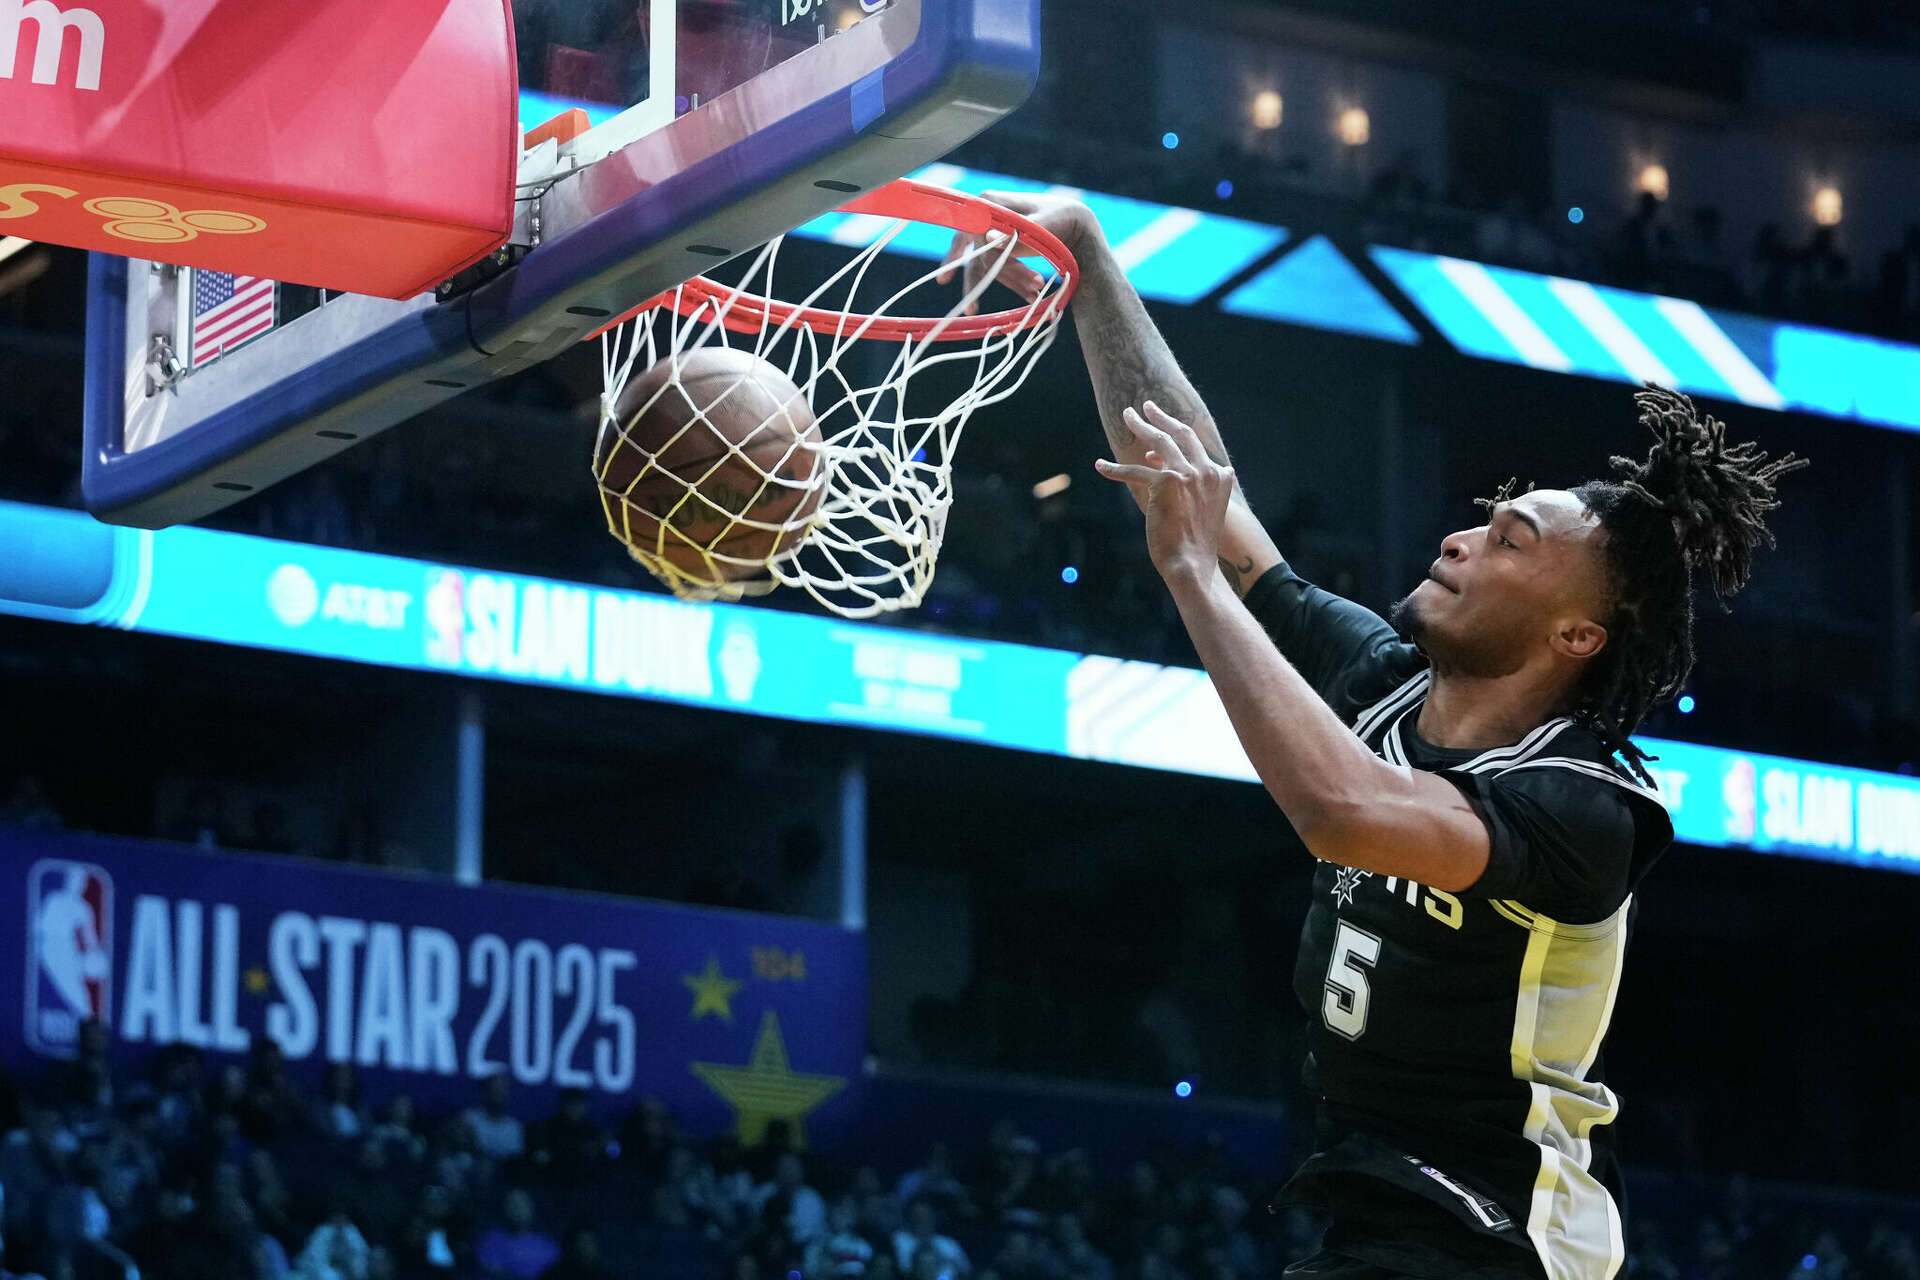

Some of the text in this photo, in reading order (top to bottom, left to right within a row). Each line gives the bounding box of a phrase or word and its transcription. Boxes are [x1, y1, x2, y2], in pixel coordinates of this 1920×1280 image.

[467, 576, 589, 682] SLAM
[594, 594, 713, 698] DUNK
[1762, 768, 1852, 849] SLAM
[119, 894, 638, 1093] ALL STAR 2025
[1321, 917, 1383, 1042] 5
